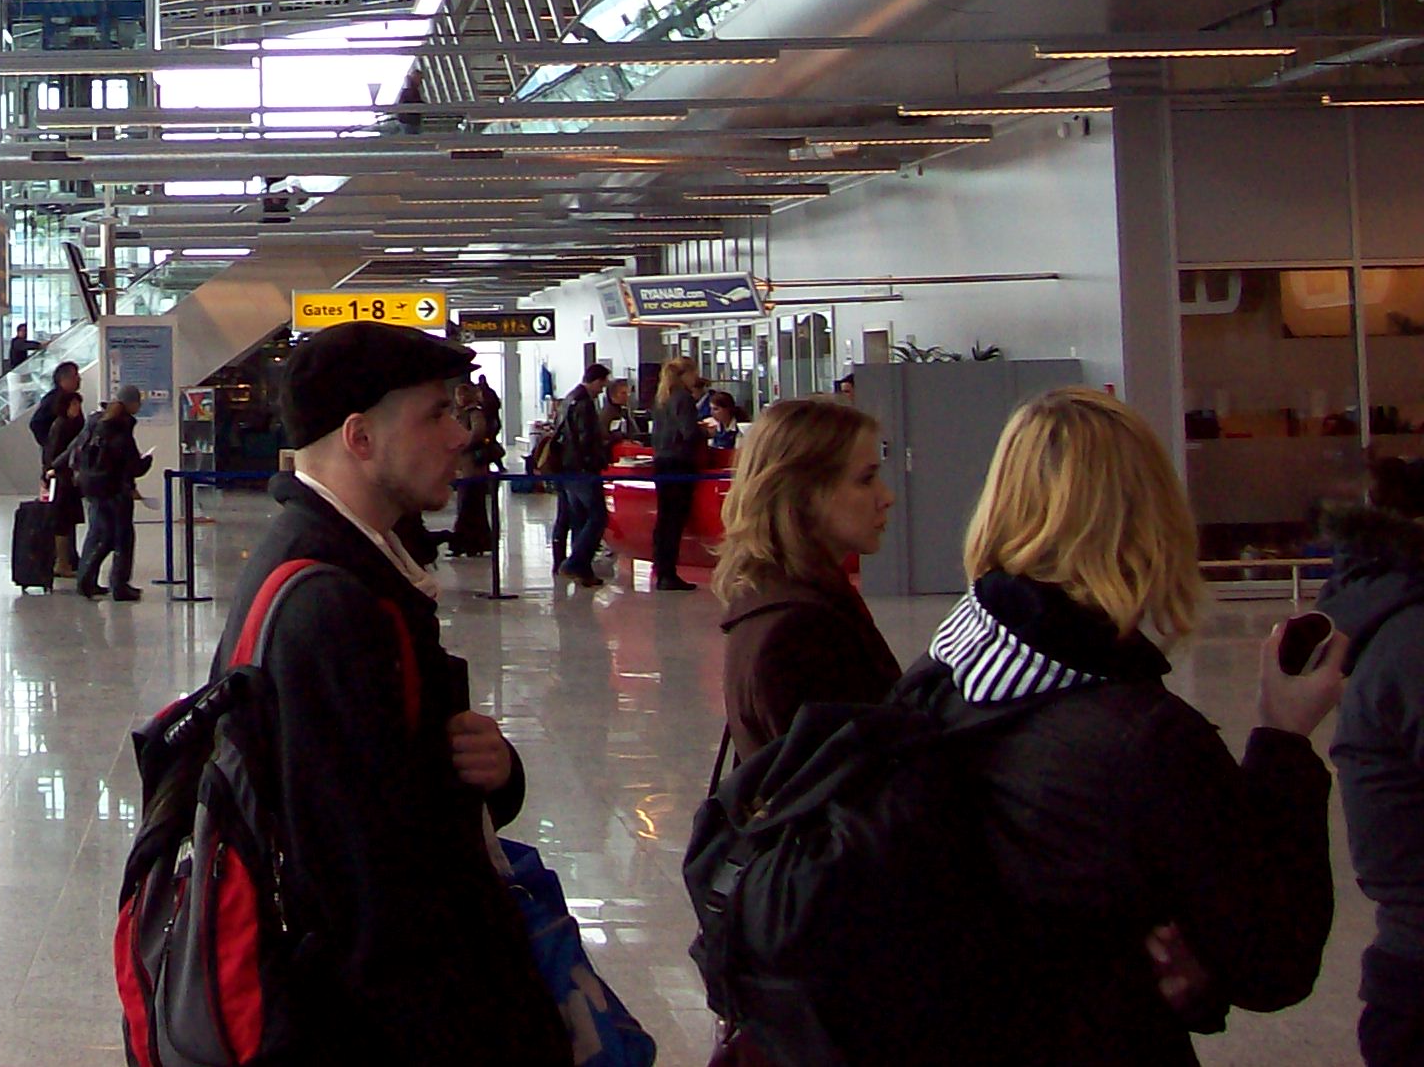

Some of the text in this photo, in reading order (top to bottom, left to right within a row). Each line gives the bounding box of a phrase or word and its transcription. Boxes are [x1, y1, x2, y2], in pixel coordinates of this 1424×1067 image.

[302, 299, 386, 320] Gates 1-8
[661, 301, 708, 309] CHEAPER
